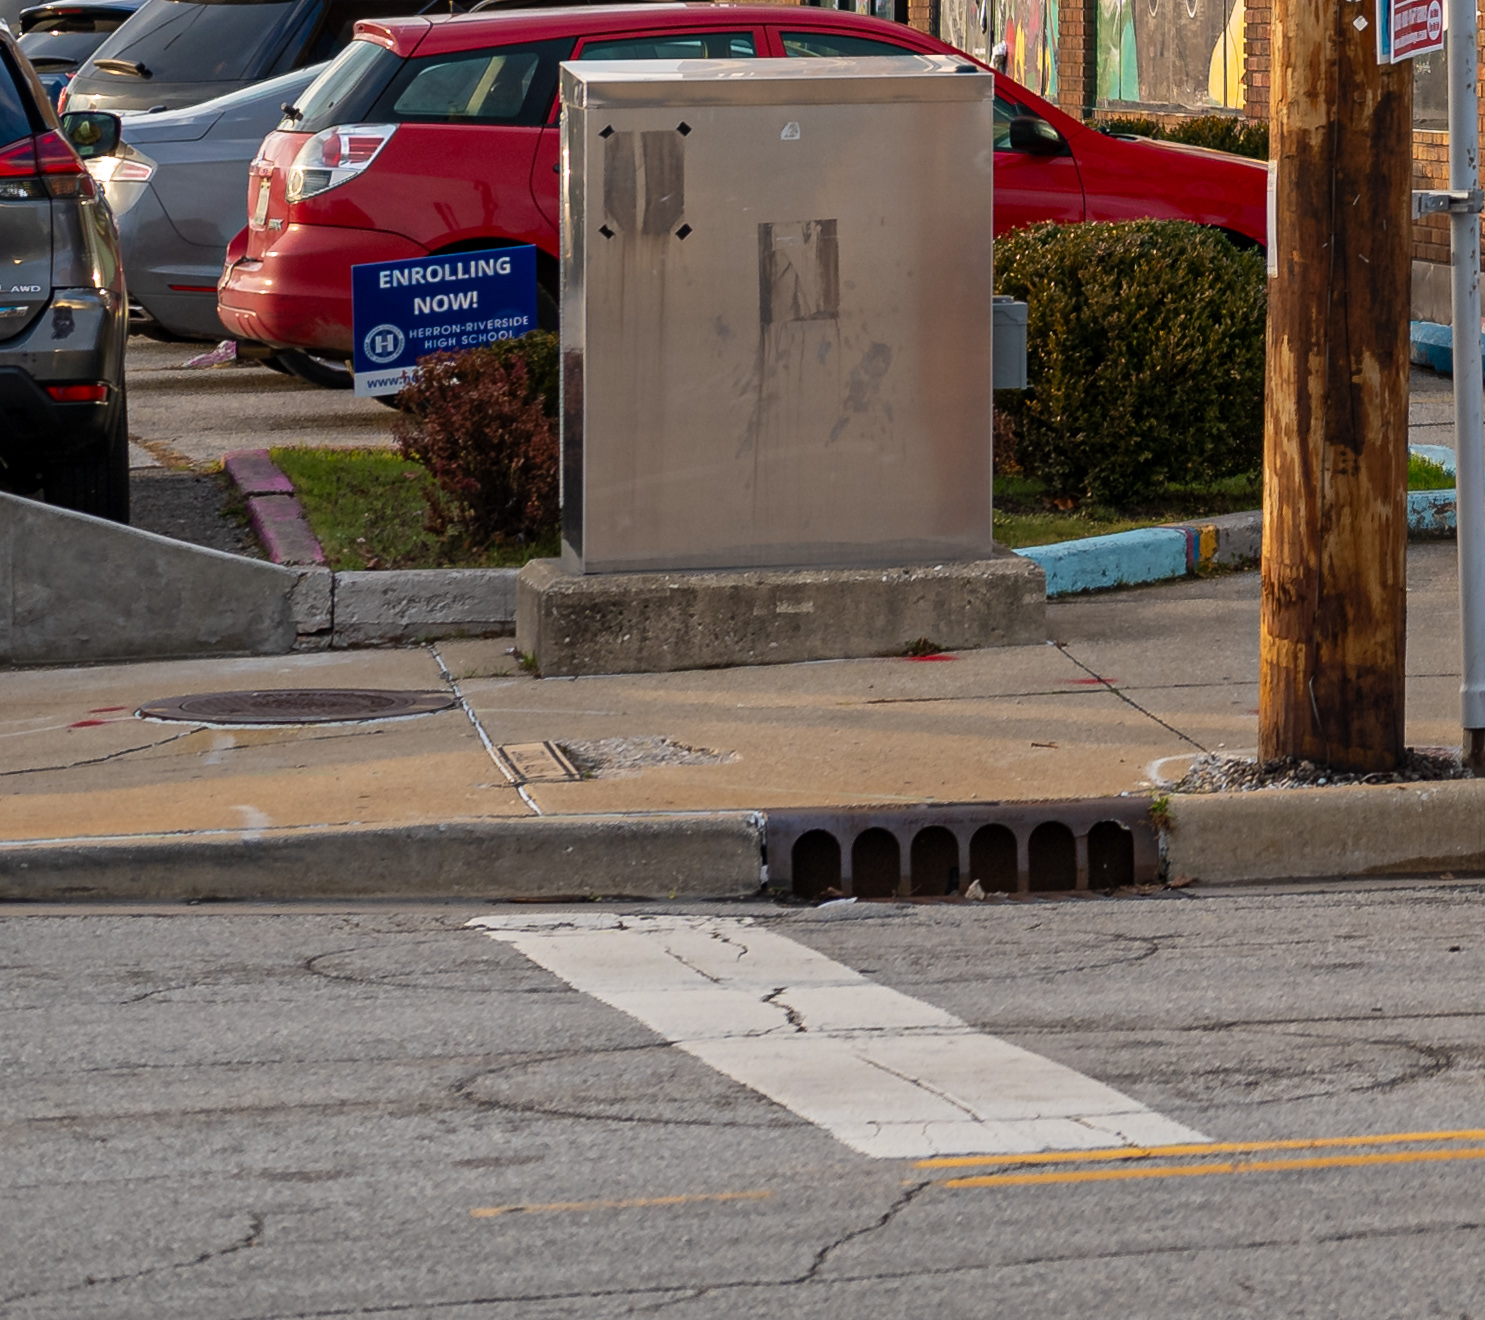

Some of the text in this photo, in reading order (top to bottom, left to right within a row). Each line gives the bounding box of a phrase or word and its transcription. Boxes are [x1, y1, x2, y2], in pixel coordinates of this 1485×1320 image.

[379, 256, 511, 289] ENROLLING
[10, 285, 41, 293] AWD
[413, 291, 478, 315] NOW!
[409, 315, 529, 339] HERRON-RIVERSIDE
[374, 334, 395, 354] H
[424, 330, 515, 349] HIGH SCHOOL
